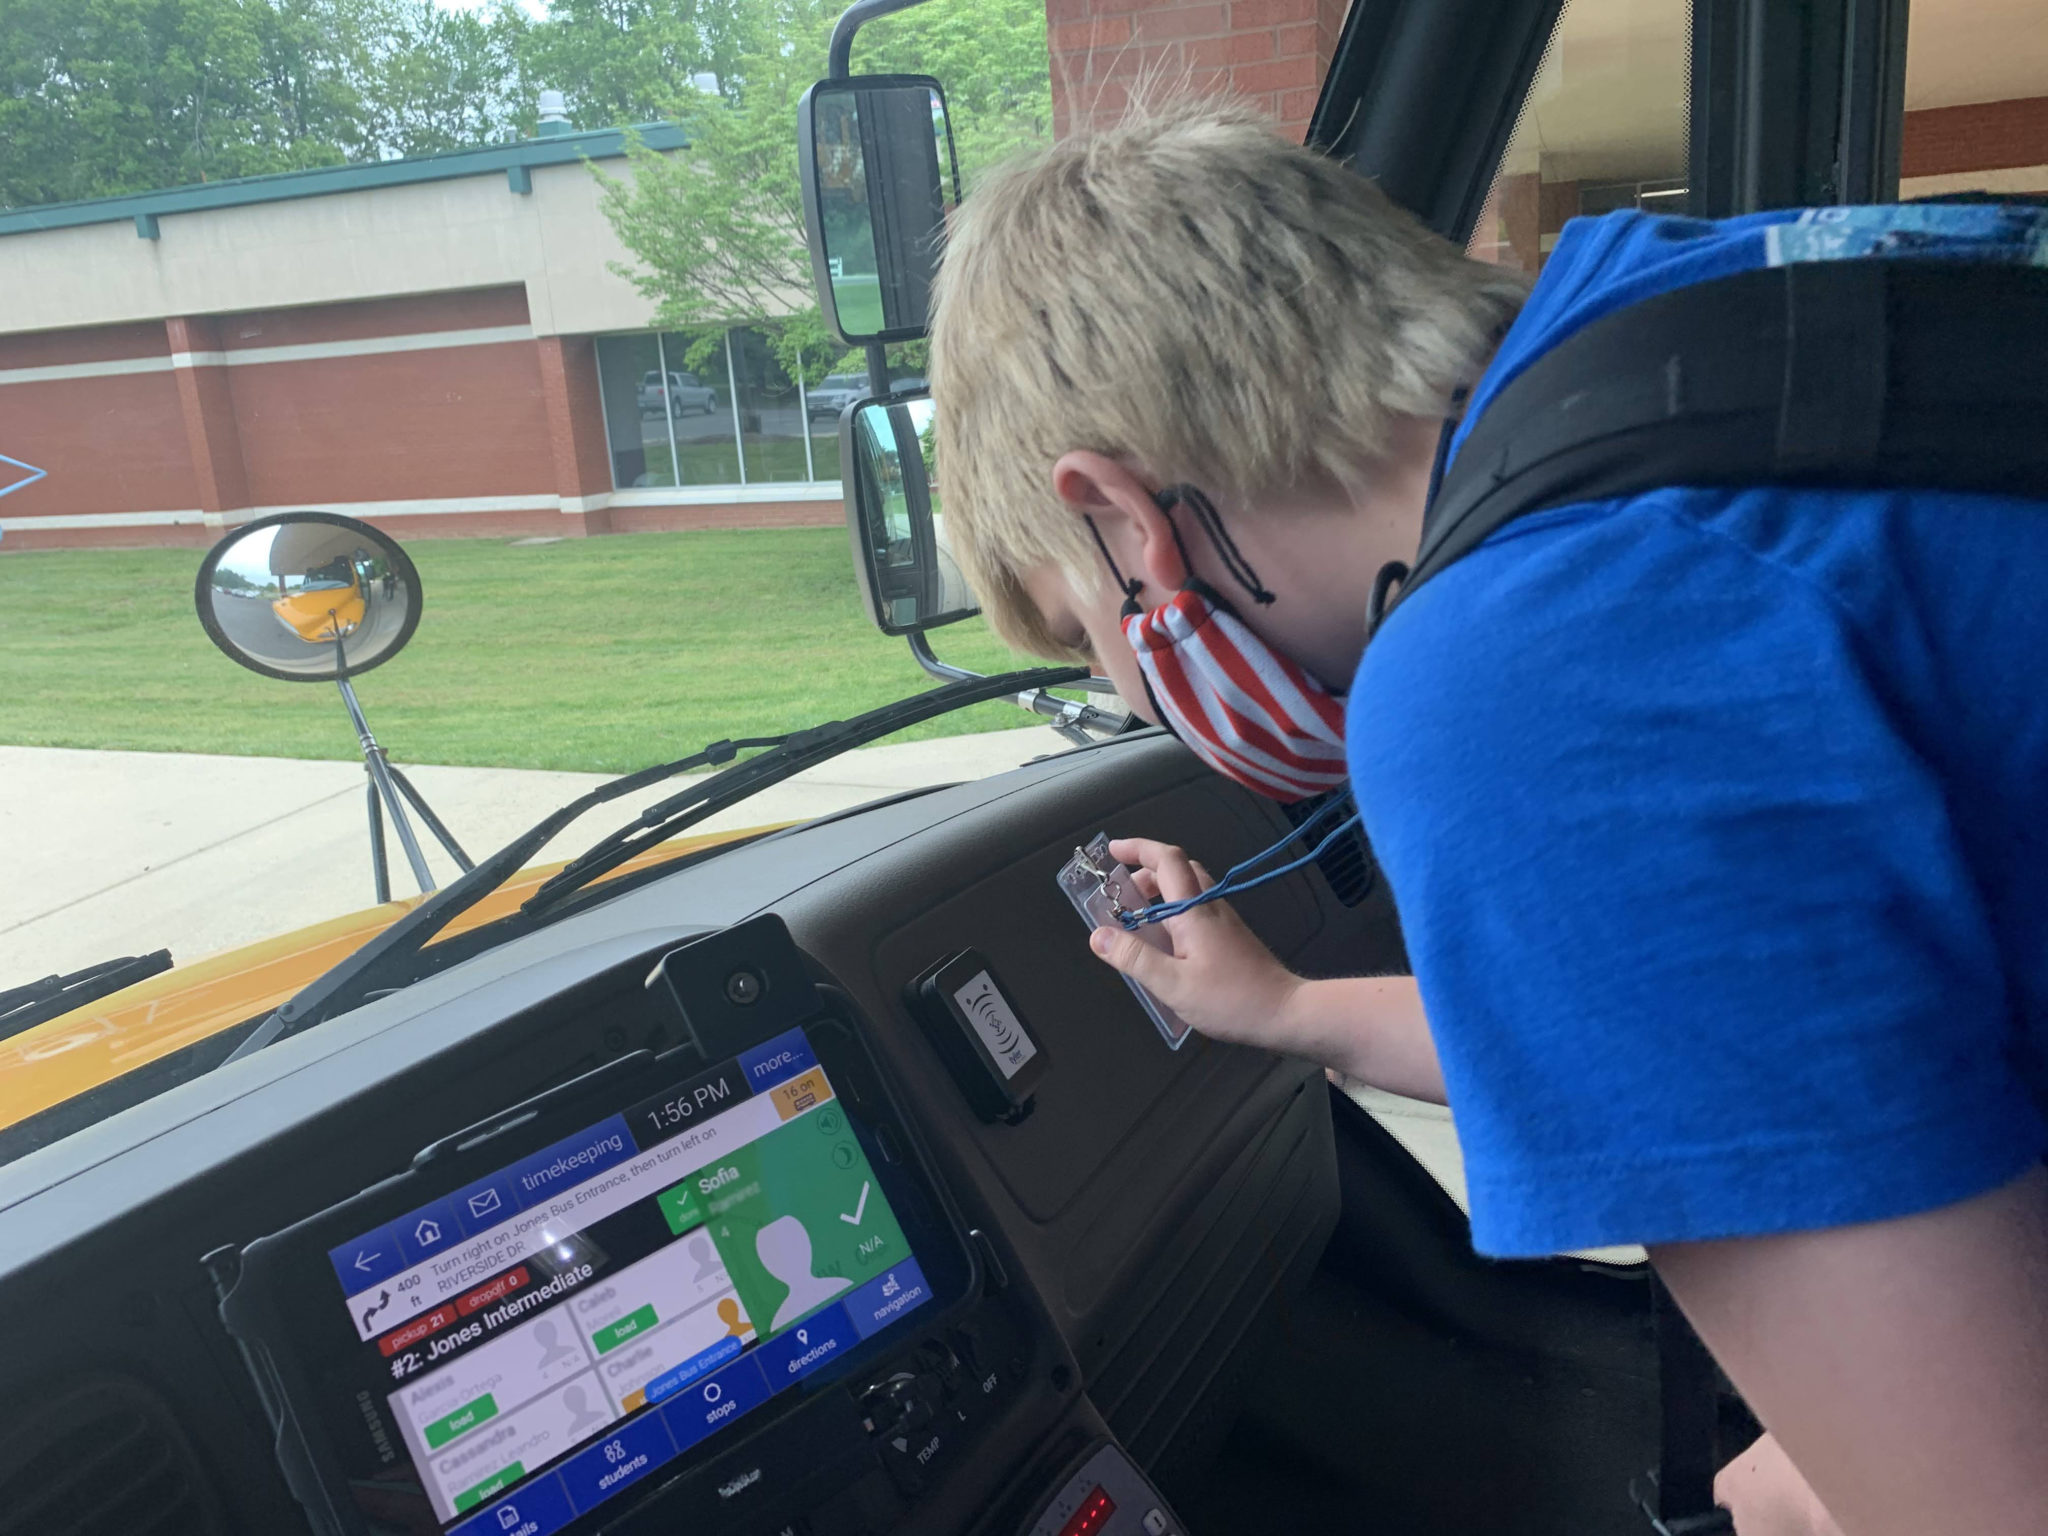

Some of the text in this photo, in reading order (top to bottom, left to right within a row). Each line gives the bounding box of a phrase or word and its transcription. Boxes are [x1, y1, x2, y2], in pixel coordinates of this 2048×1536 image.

[753, 1048, 804, 1078] more...
[647, 1077, 731, 1131] 1:56 PM
[783, 1078, 815, 1100] 16 on
[521, 1134, 624, 1191] timekeeping
[698, 1165, 740, 1195] Sofia
[430, 1126, 717, 1279] Turn right on Jones Bus Entrance, then turn left on
[858, 1235, 884, 1255] N/A
[437, 1240, 527, 1293] RIVERSIDE DR
[397, 1275, 421, 1294] 400
[468, 1275, 518, 1308] dropoff 0
[410, 1296, 422, 1308] ft
[873, 1285, 922, 1321] navigation
[390, 1262, 593, 1379] #2: Jones Intermediate
[391, 1314, 445, 1349] pickup 21
[614, 1320, 638, 1339] load
[607, 1347, 654, 1379] Charlie
[651, 1343, 740, 1398] Jones Bus Entrance
[788, 1337, 837, 1374] directions
[982, 1372, 998, 1394] OFF
[356, 1390, 395, 1463] SAMSUNG
[449, 1411, 475, 1431] load
[706, 1399, 737, 1425] stops
[957, 1411, 967, 1422] L
[439, 1424, 517, 1476] Cassandra
[917, 1436, 941, 1465] TEMP
[599, 1453, 648, 1490] students
[478, 1479, 505, 1500] load
